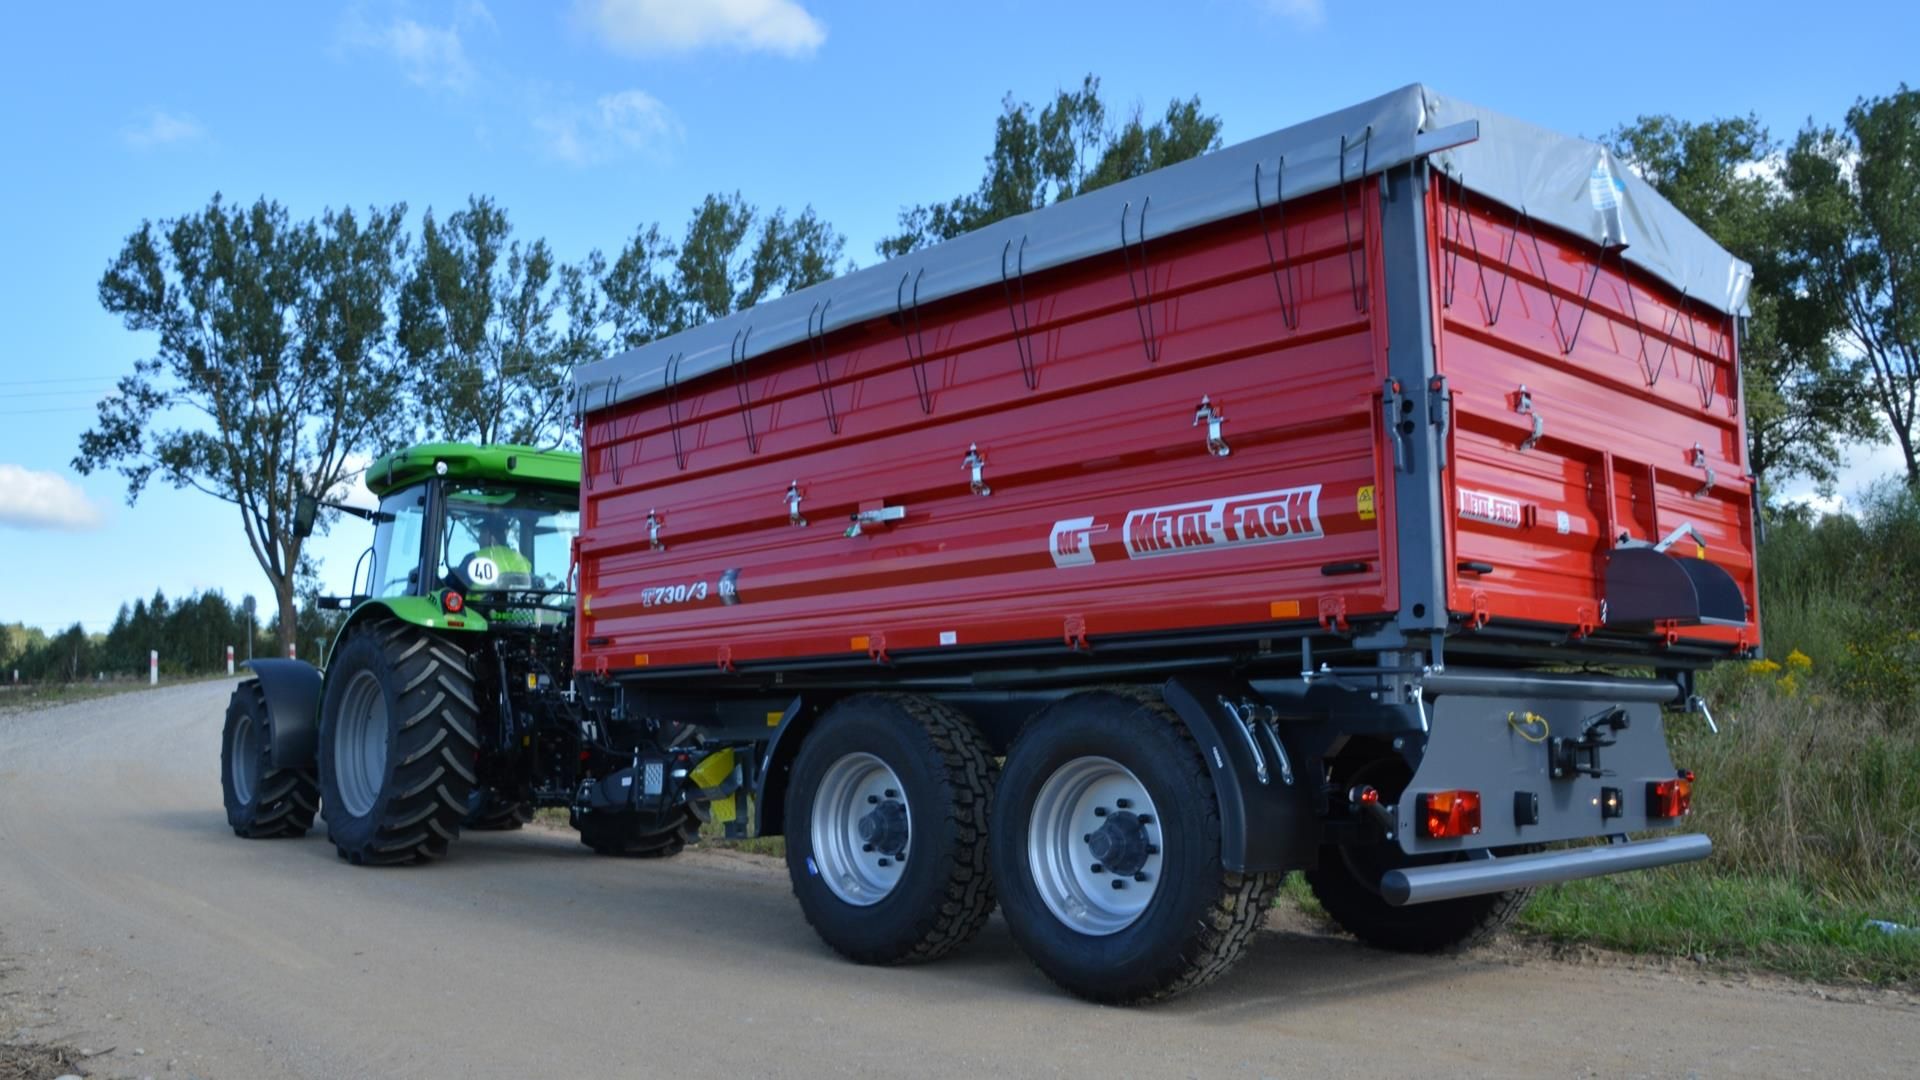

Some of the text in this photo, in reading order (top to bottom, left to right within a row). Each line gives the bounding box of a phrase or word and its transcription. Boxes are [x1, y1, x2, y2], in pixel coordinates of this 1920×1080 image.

[1130, 490, 1315, 553] METAL-FACH
[1056, 526, 1101, 556] MF
[475, 563, 492, 580] 40
[641, 581, 708, 608] T730/3
